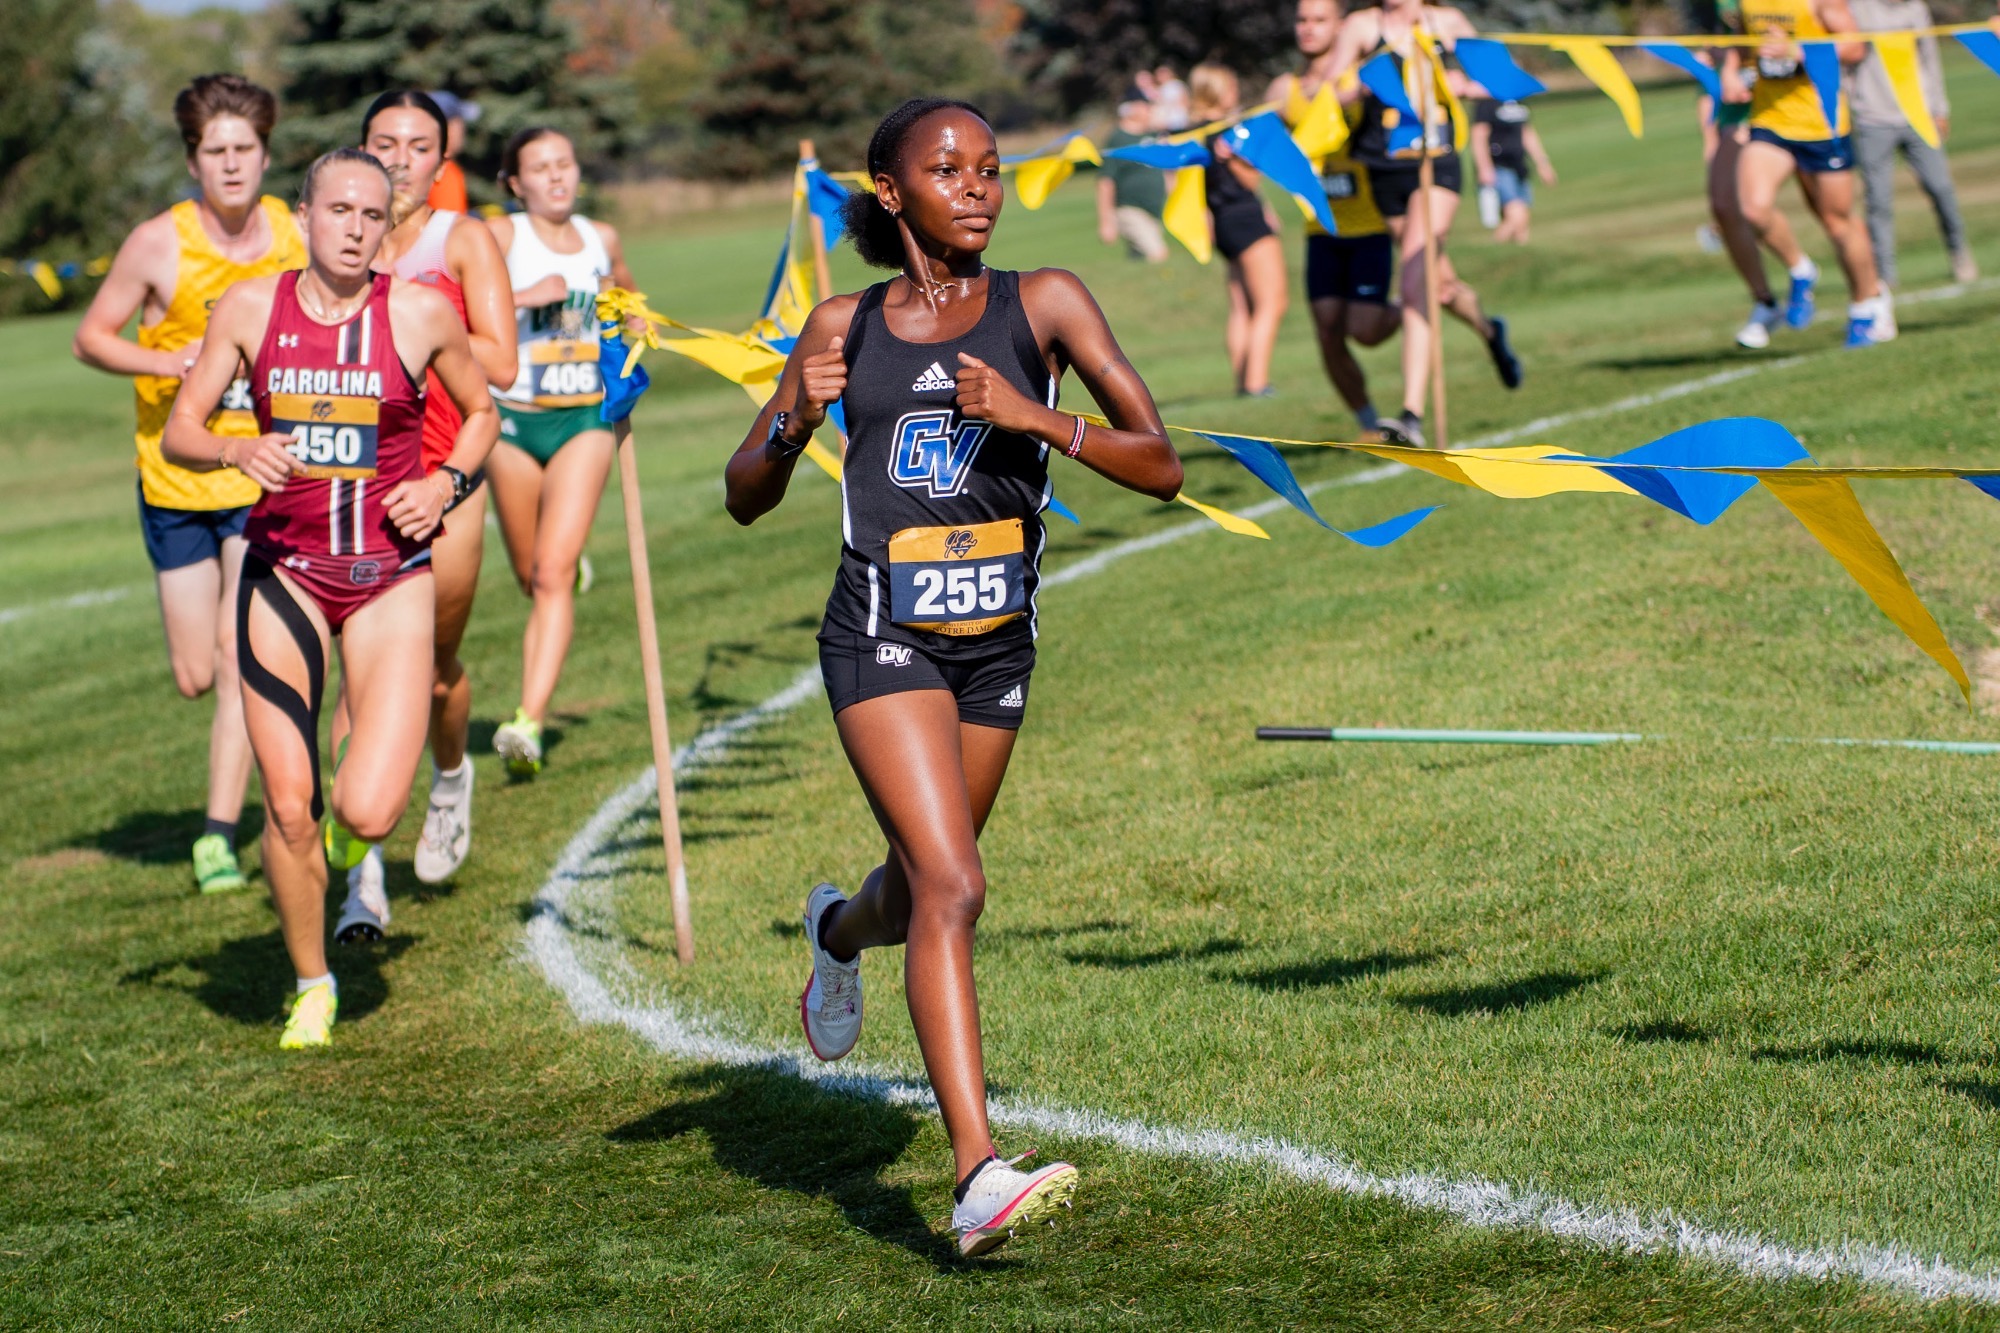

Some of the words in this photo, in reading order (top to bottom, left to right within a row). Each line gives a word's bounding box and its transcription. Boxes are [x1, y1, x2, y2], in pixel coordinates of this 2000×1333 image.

[268, 367, 382, 396] CAROLINA
[540, 363, 598, 394] 406
[912, 379, 955, 392] adidas
[286, 425, 362, 465] 450
[888, 410, 994, 498] GV
[913, 564, 1007, 615] 255
[932, 626, 965, 634] NOTRE
[967, 624, 992, 634] DAME
[999, 699, 1023, 708] adidas
